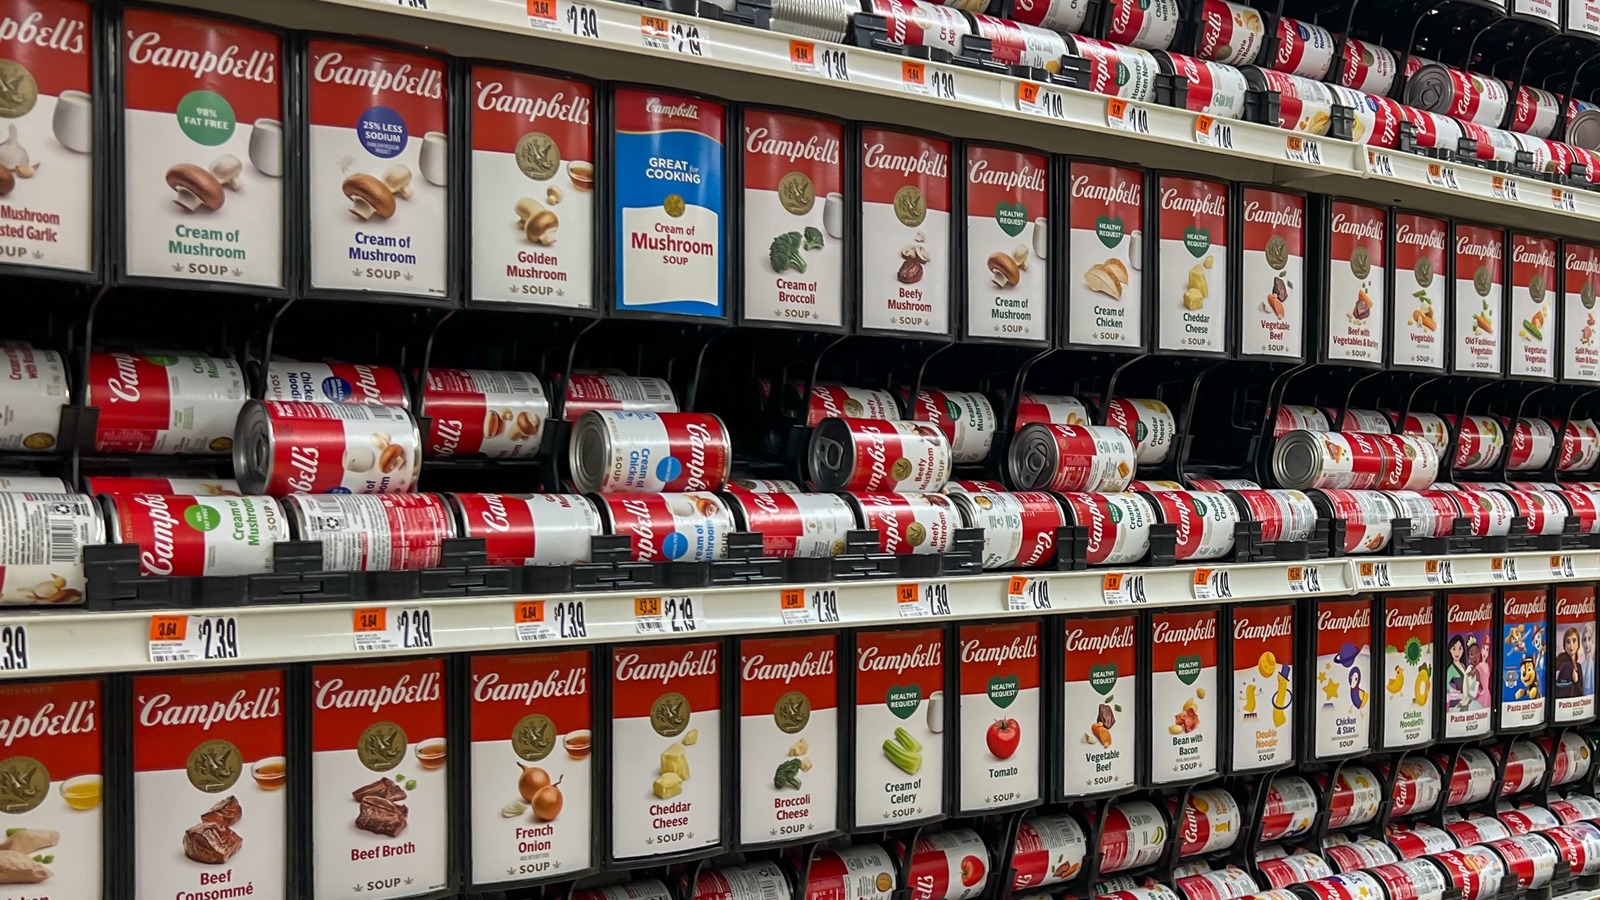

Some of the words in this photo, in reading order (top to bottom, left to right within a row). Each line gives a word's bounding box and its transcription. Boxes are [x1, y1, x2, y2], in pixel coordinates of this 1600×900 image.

[127, 30, 276, 84] Campbell's
[314, 52, 442, 100] Campbell's
[476, 81, 590, 125] Campbell's
[646, 97, 699, 119] Campbell's
[196, 107, 217, 118] 98%
[184, 117, 202, 126] FAT
[204, 119, 230, 130] FREE
[363, 121, 381, 130] 25%
[382, 123, 403, 133] LESS
[365, 131, 401, 143] SODIUM
[746, 127, 839, 165] Campbell's
[649, 157, 688, 171] GREAT
[864, 143, 948, 178] Campbell's
[646, 168, 700, 184] COOKING
[969, 160, 1045, 192] Campbell's
[1071, 175, 1141, 206] Campbell's
[1161, 188, 1225, 217] Campbell's
[1, 205, 60, 226] Mushroom
[1000, 210, 1024, 218] HEALTHY
[1244, 201, 1302, 228] Campbell's
[26, 226, 58, 243] Garlic
[175, 224, 222, 240] Cream
[225, 230, 240, 243] of
[655, 222, 684, 235] Cream
[686, 226, 695, 236] of
[1099, 223, 1121, 231] HEALTHY
[355, 232, 396, 247] Cream
[398, 236, 411, 249] of
[631, 232, 713, 256] Mushroom
[168, 240, 246, 260] Mushroom
[348, 247, 416, 265] Mushroom
[517, 251, 558, 266] Golden
[188, 263, 228, 276] SOUP
[366, 268, 401, 280] SOUP
[506, 265, 567, 281] Mushroom
[522, 285, 554, 296] SOUP
[776, 278, 807, 291] Cream
[808, 281, 817, 292] of
[779, 291, 815, 305] Broccoli
[899, 288, 922, 301] Beefy
[888, 300, 932, 312] Mushroom
[995, 297, 1020, 308] Cream
[1021, 299, 1029, 309] of
[992, 308, 1031, 321] Mushroom
[1094, 306, 1117, 316] Cream
[1118, 307, 1125, 317] of
[1183, 313, 1209, 323] Cheddar
[1096, 317, 1122, 328] Chicken
[1185, 324, 1208, 334] Cheese
[1261, 320, 1290, 331] Vegetable
[1270, 332, 1283, 340] Beef
[1348, 327, 1360, 335] Beef
[1410, 333, 1435, 344] Vegetable
[1333, 336, 1362, 347] Vegetables
[1465, 337, 1475, 345] Old
[1470, 346, 1493, 356] Vegetable
[964, 402, 976, 427] Cream
[614, 457, 623, 482] SOUP
[625, 451, 640, 486] Chicken
[639, 448, 651, 479] Cream
[915, 458, 926, 483] Beefy
[919, 447, 934, 490] Mushroom
[935, 459, 944, 482] SOUP
[1132, 500, 1142, 527] Chicken
[1215, 497, 1226, 519] Cheese
[232, 507, 245, 541] Cream
[241, 496, 260, 546] Mushroom
[264, 505, 278, 531] SOUP
[1127, 507, 1136, 529] Cream
[696, 525, 704, 534] of
[930, 522, 940, 547] Beefy
[719, 532, 728, 558] SOUP
[812, 590, 839, 622] $2.39
[925, 584, 951, 615] $2.39
[554, 602, 587, 638] $2.39
[665, 598, 697, 631] $2.19
[1318, 608, 1370, 633] Campbell's
[397, 610, 433, 648] $2.39
[1153, 618, 1216, 646] Campbell's
[1233, 615, 1291, 642] Campbell's
[199, 618, 238, 659] $2.39
[1065, 625, 1134, 654] Campbell's
[961, 635, 1037, 666] Campbell's
[858, 643, 941, 674] Campbell's
[615, 649, 717, 684] Campbell's
[742, 650, 834, 684] Campbell's
[315, 672, 441, 712] Campbell's
[473, 668, 587, 705] Campbell's
[991, 682, 1015, 691] HEALTHY
[891, 692, 917, 701] HEALTHY
[139, 687, 281, 730] Campbell's
[1507, 704, 1521, 712] Pasta
[1522, 703, 1530, 711] and
[1558, 701, 1571, 709] Pasta
[1336, 716, 1356, 726] Chicken
[1402, 711, 1421, 720] Chicken
[1450, 714, 1466, 723] Pasta
[1466, 713, 1475, 721] and
[1255, 729, 1277, 739] Double
[1342, 725, 1356, 734] Stars
[1173, 736, 1190, 746] Bean
[1190, 734, 1203, 743] with
[1255, 738, 1278, 748] Noodle
[1086, 750, 1120, 763] Vegetable
[1179, 746, 1198, 756] Bacon
[989, 766, 1018, 778] Tomato
[1096, 762, 1112, 773] Beef
[885, 782, 912, 793] Cream
[913, 778, 921, 789] of
[774, 794, 811, 808] Broccoli
[891, 792, 917, 804] Celery
[650, 802, 691, 816] Cheddar
[776, 807, 809, 821] Cheese
[653, 816, 688, 829] Cheese
[515, 824, 553, 839] French
[351, 847, 379, 861] Beef
[383, 842, 415, 858] Broth
[519, 840, 551, 853] Onion
[520, 862, 550, 874] SOUP
[200, 870, 232, 885] Beef
[367, 878, 401, 891] SOUP
[176, 882, 254, 900] Consommé
